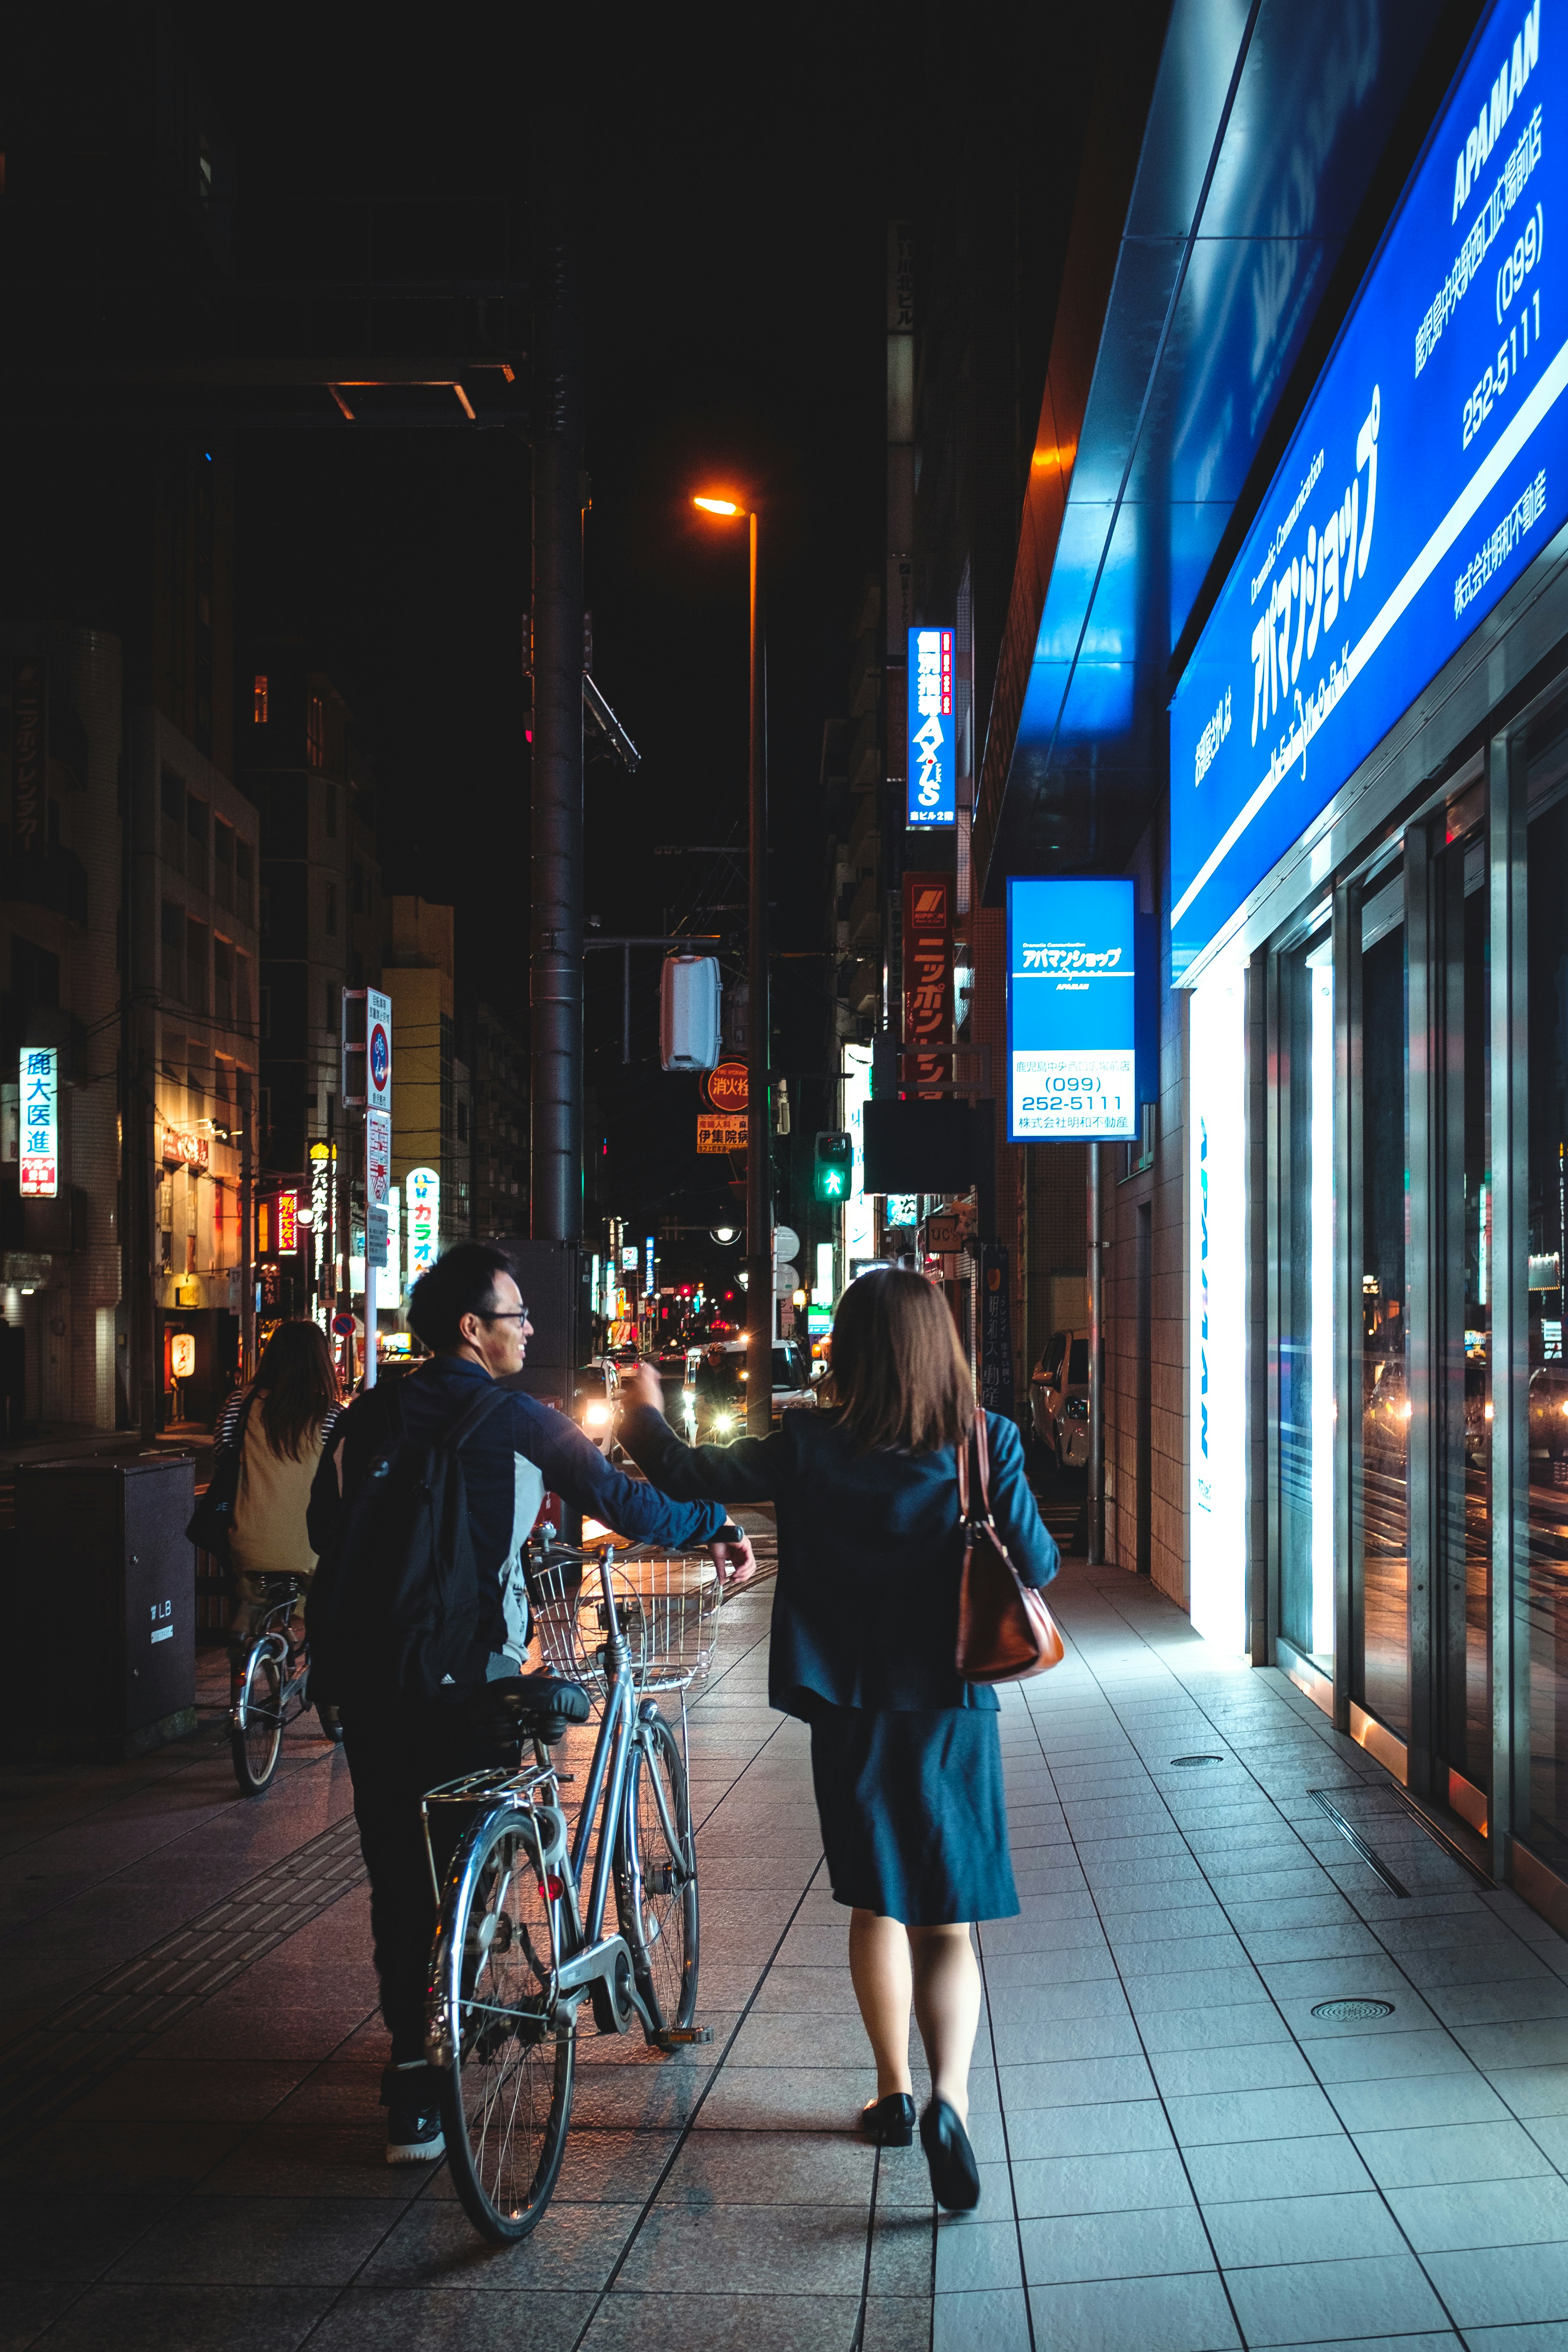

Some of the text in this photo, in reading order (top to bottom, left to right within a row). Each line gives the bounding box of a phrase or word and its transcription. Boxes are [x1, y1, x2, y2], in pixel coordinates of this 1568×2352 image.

[1452, 0, 1541, 225] APAMAN
[1496, 201, 1543, 326] (099)
[1463, 288, 1540, 452] 252-5111
[1251, 448, 1324, 606] Dramatic Communication
[1251, 383, 1380, 748] アパマンショップ
[1453, 467, 1546, 621] 株式会社明和不動産
[1022, 948, 1122, 968] アパマンショップ
[26, 1053, 51, 1153] 鹿大医進
[1019, 1116, 1128, 1129] 株式会社明和不動産
[1022, 1096, 1120, 1111] 252-5111
[1045, 1077, 1101, 1093] (099)
